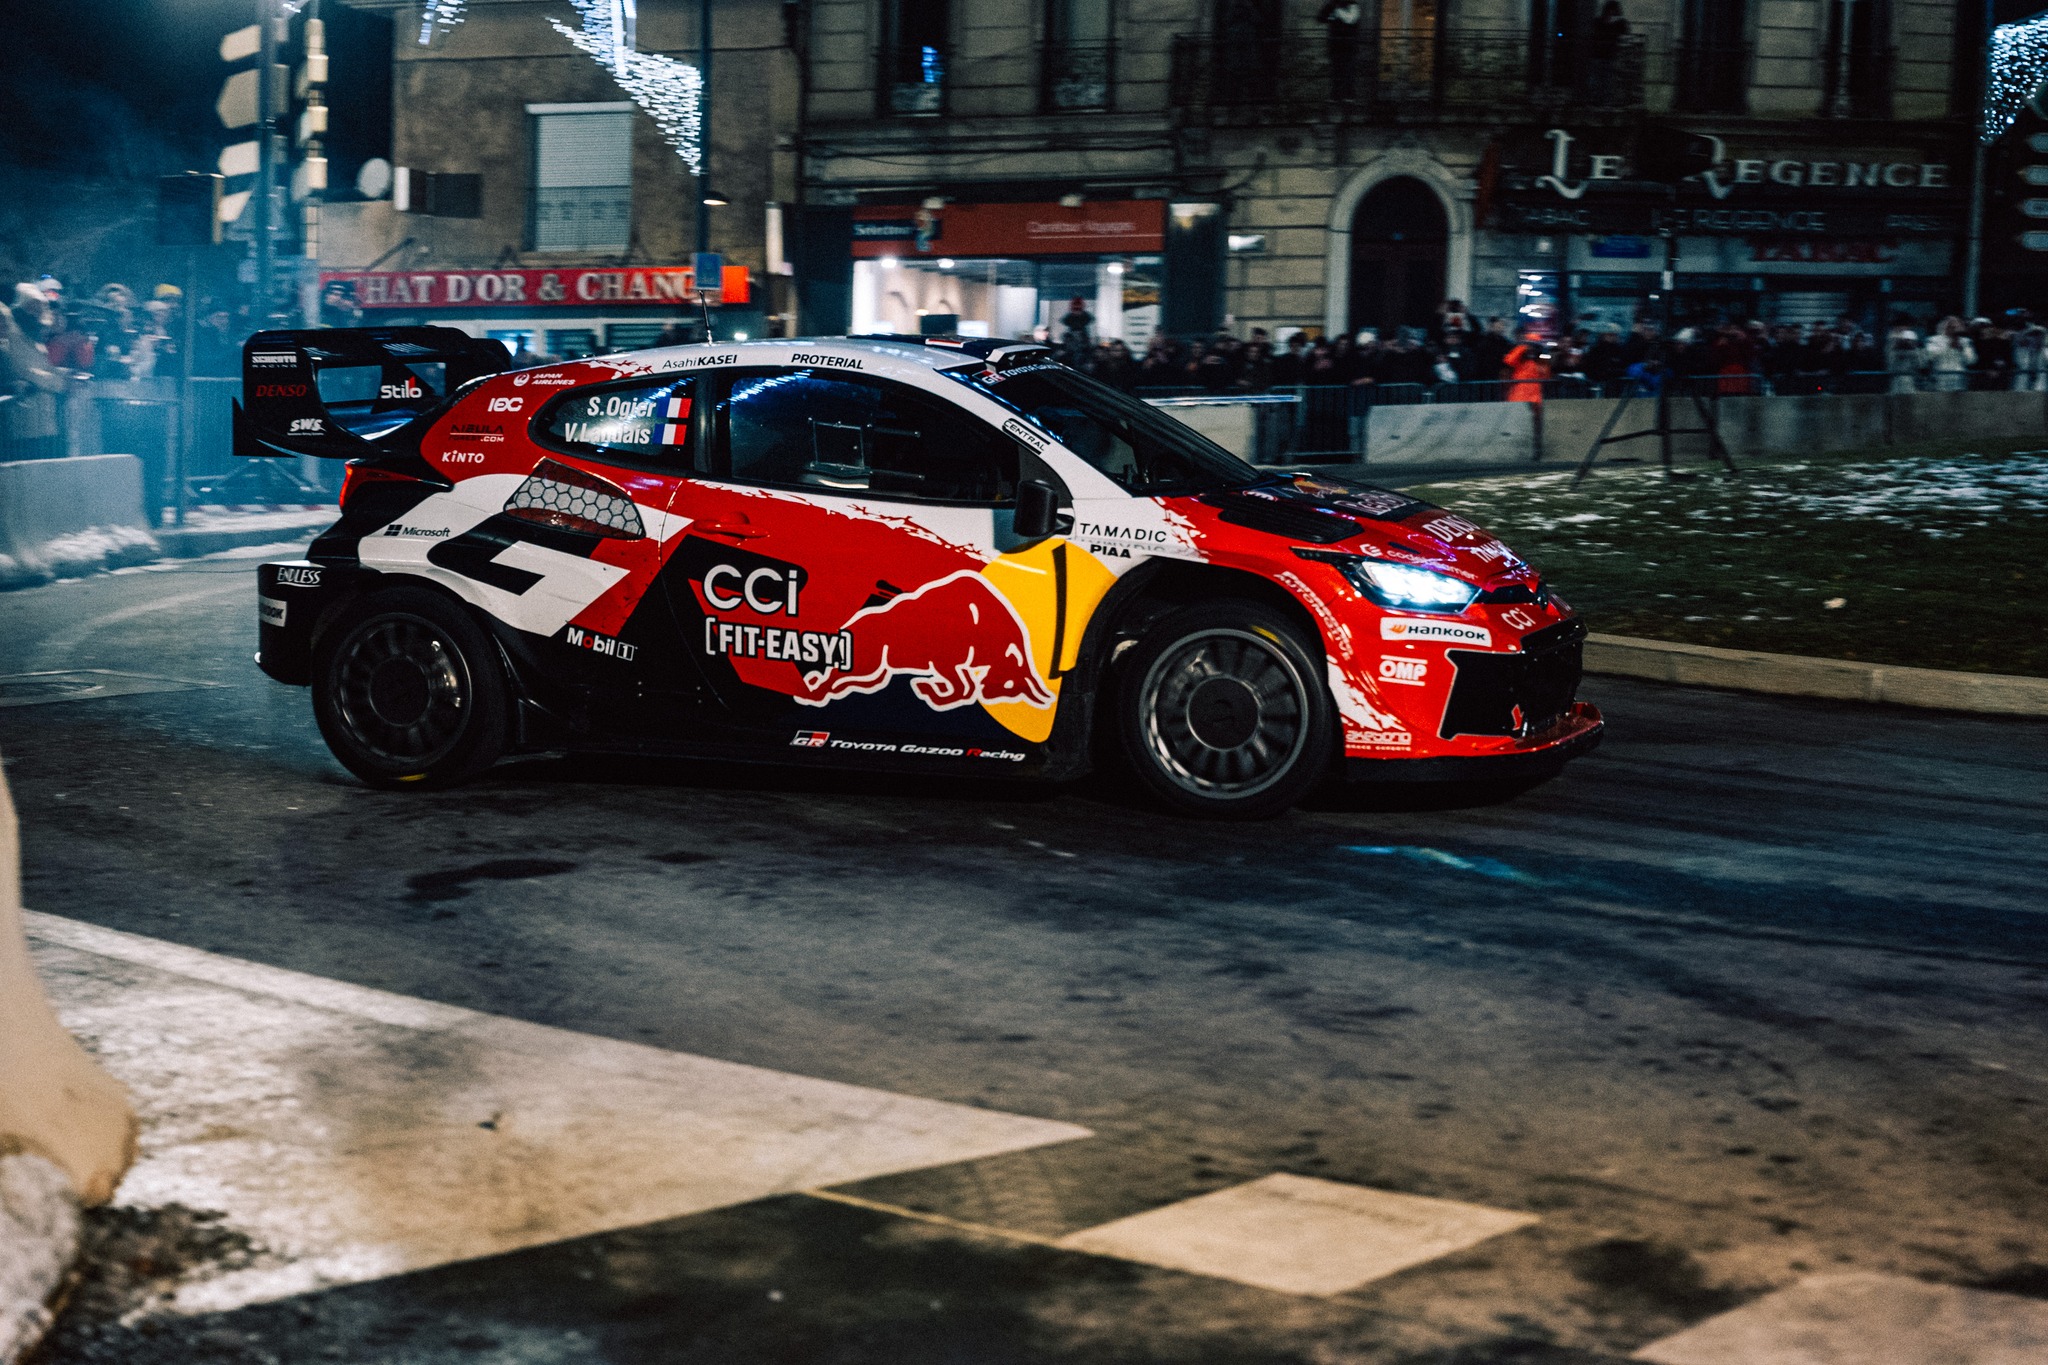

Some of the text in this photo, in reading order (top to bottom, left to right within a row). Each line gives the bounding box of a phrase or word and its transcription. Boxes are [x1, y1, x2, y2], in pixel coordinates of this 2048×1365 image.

[351, 275, 436, 304] HAT
[537, 274, 567, 300] &
[790, 353, 865, 370] PROTERIAL
[255, 384, 308, 398] DENSO
[380, 376, 422, 399] Stilo
[587, 396, 657, 420] S.Ogier
[289, 418, 326, 433] SWS
[1003, 420, 1046, 452] CENTRAL
[402, 526, 451, 538] Microsoft
[1079, 522, 1168, 543] TAMADIC
[1089, 544, 1133, 560] PIAA
[277, 566, 322, 586] ENDLESS
[566, 626, 615, 656] Mobil
[1379, 659, 1428, 681] OMP
[791, 737, 1026, 761] GR TOYOTA GAZOO Racing
